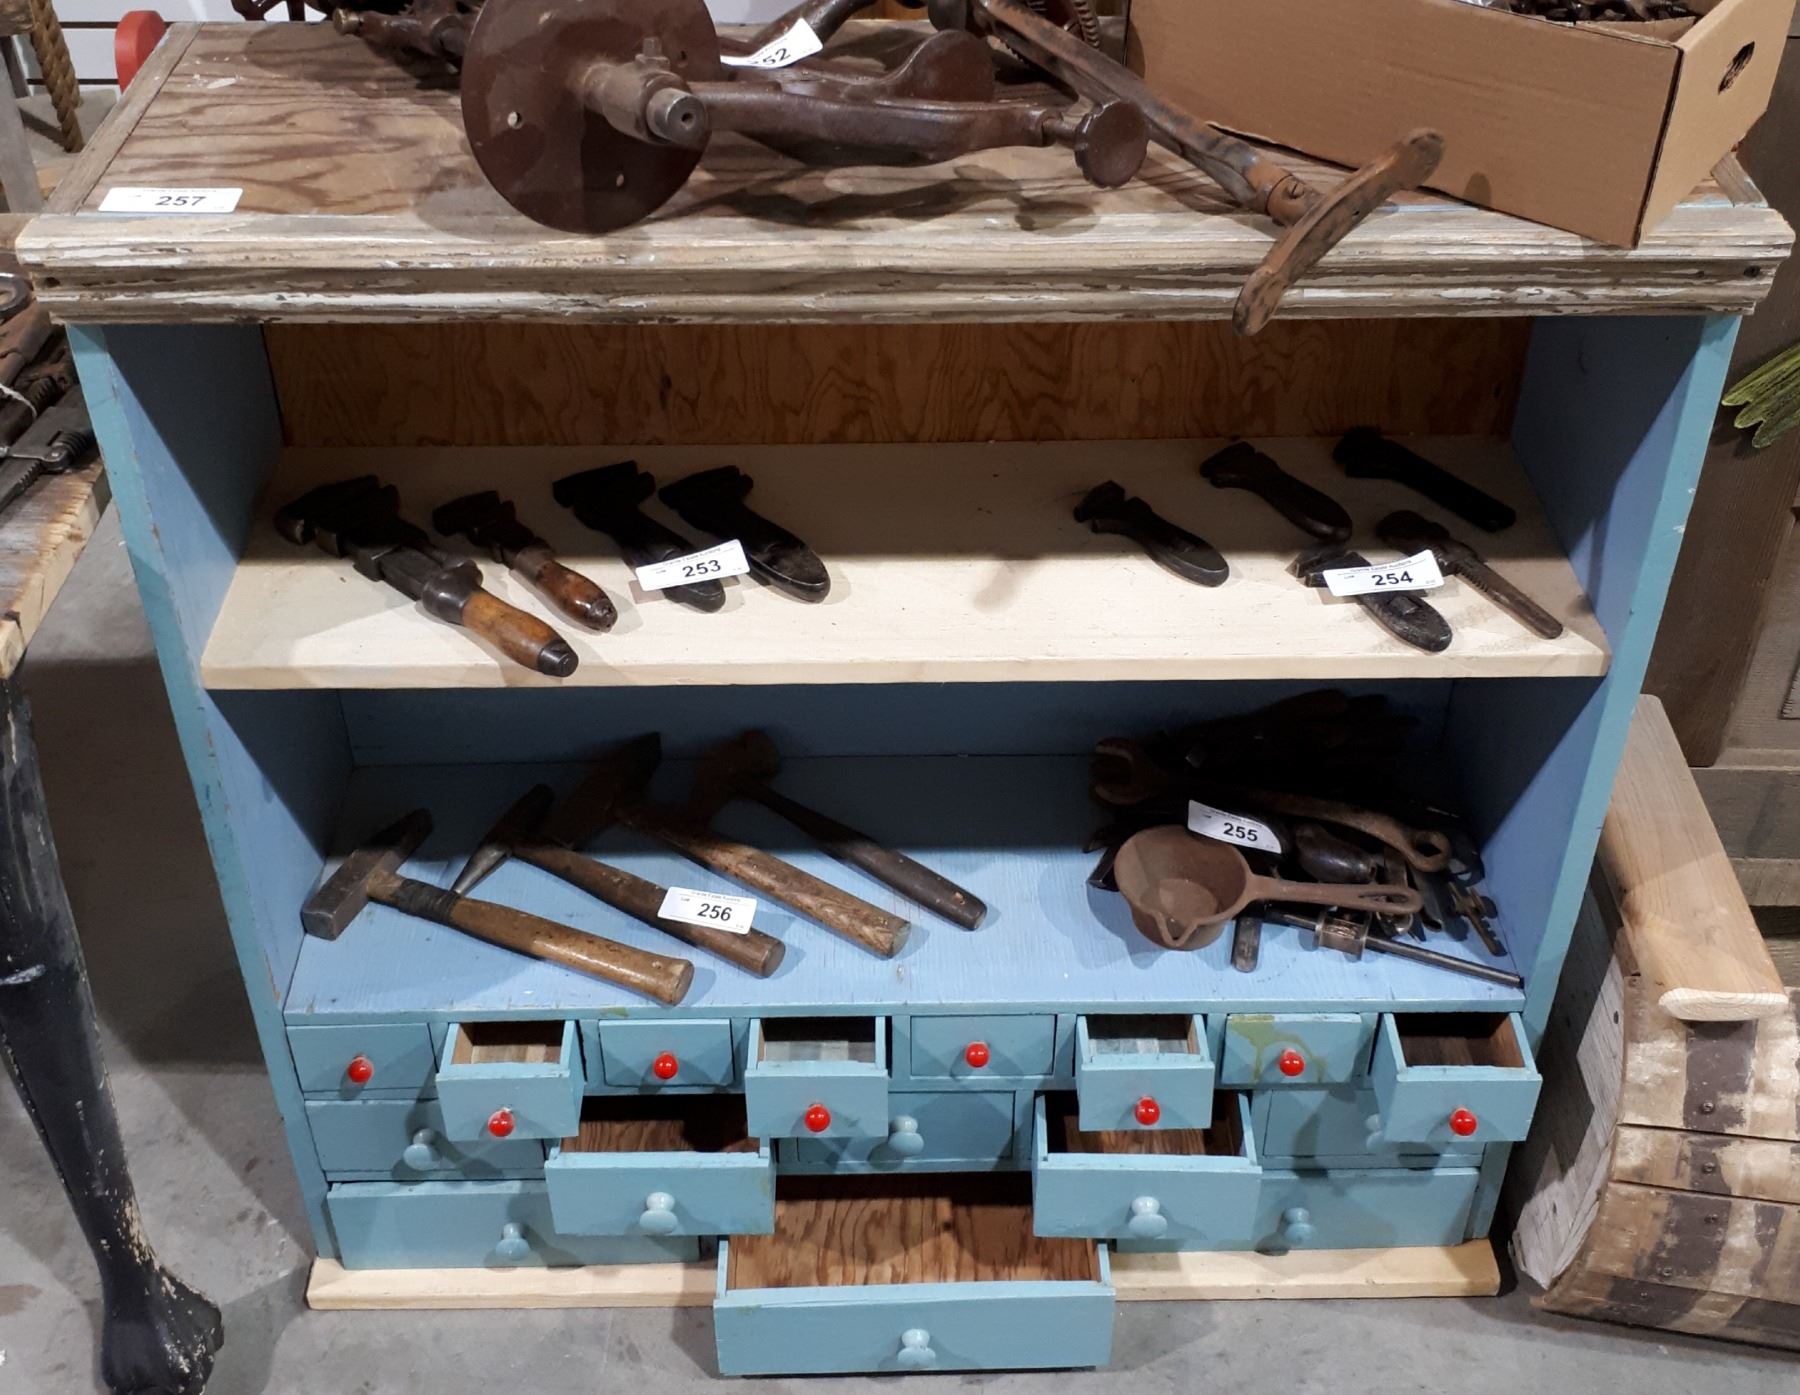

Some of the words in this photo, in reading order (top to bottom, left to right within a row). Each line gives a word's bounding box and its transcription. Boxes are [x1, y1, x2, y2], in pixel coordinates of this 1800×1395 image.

[155, 195, 207, 206] 257
[682, 559, 722, 578] 253
[1371, 570, 1414, 586] 254
[1223, 822, 1258, 842] 255
[697, 903, 733, 922] 256
